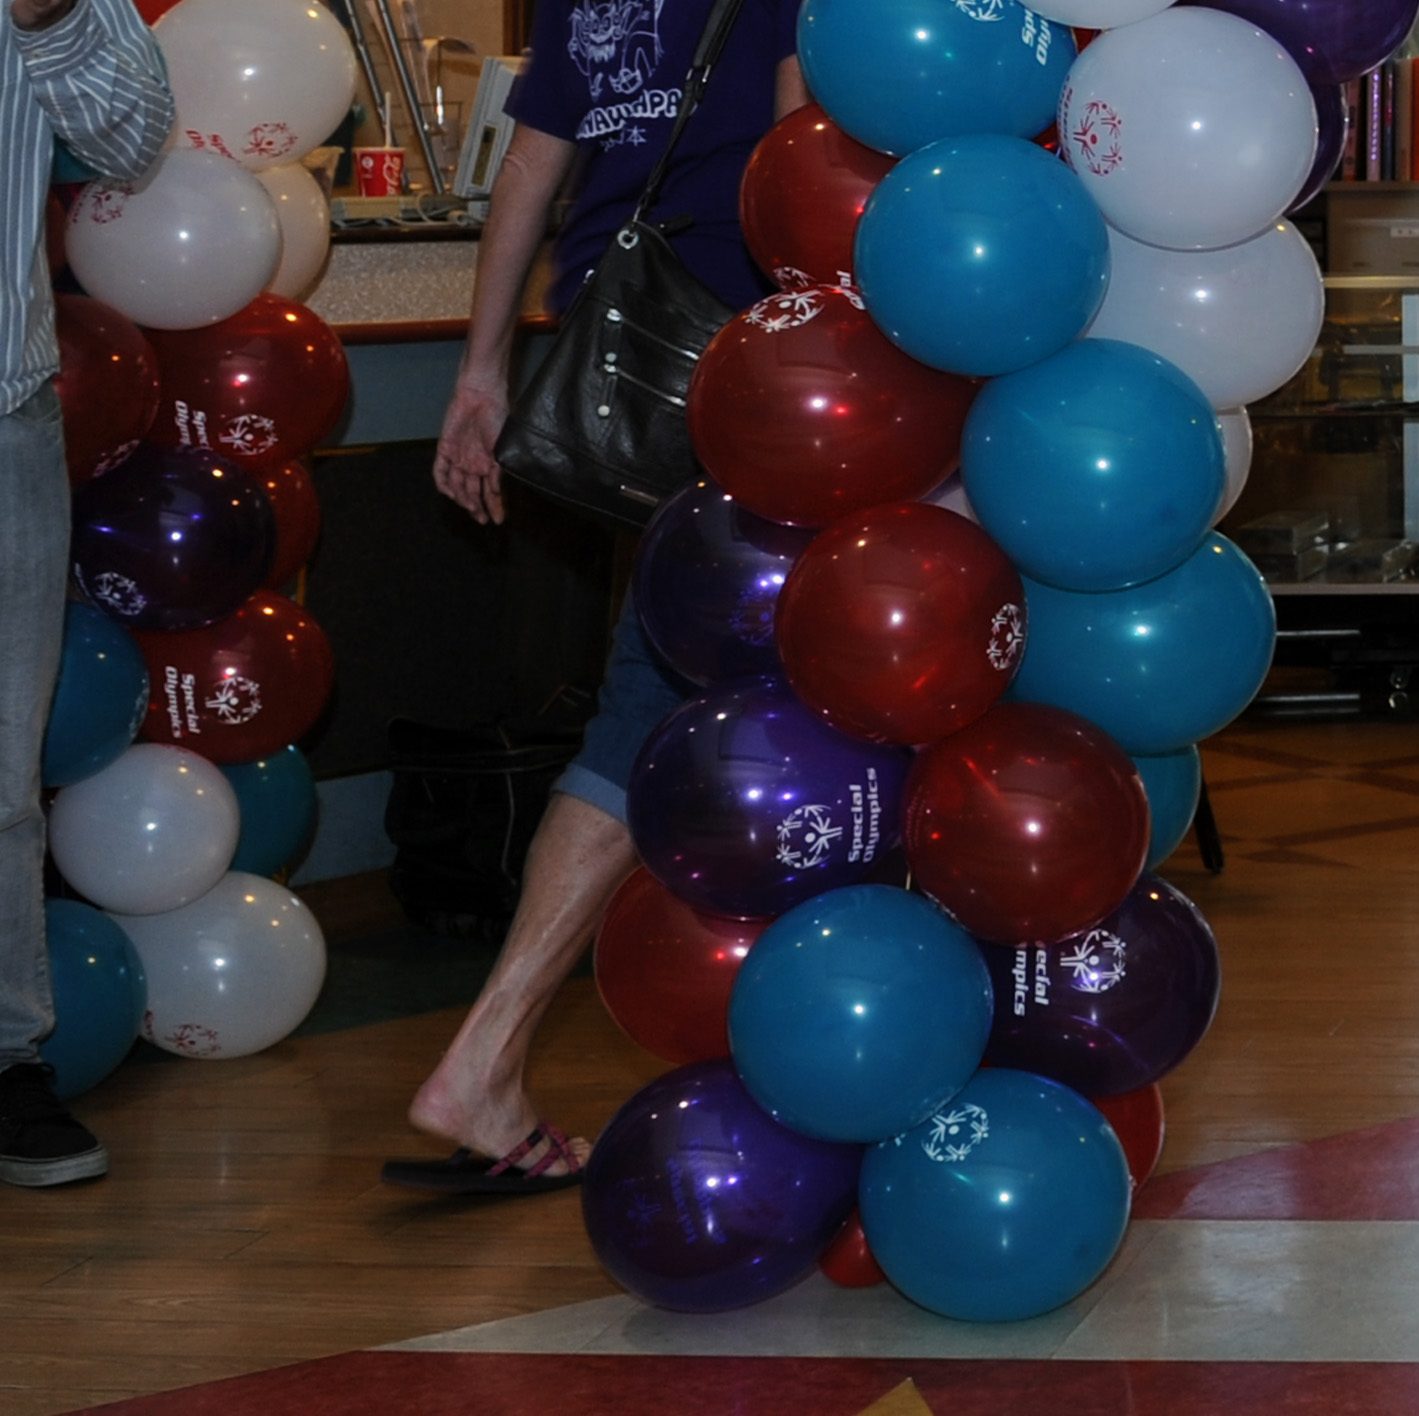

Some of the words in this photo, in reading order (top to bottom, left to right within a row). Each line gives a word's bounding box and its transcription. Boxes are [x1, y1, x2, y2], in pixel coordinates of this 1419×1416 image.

[164, 665, 182, 738] Olympics
[181, 673, 201, 734] Special
[848, 784, 864, 863] Special
[863, 768, 882, 863] Olympics
[1012, 949, 1029, 1017] mpics
[1034, 948, 1051, 1005] ecial
